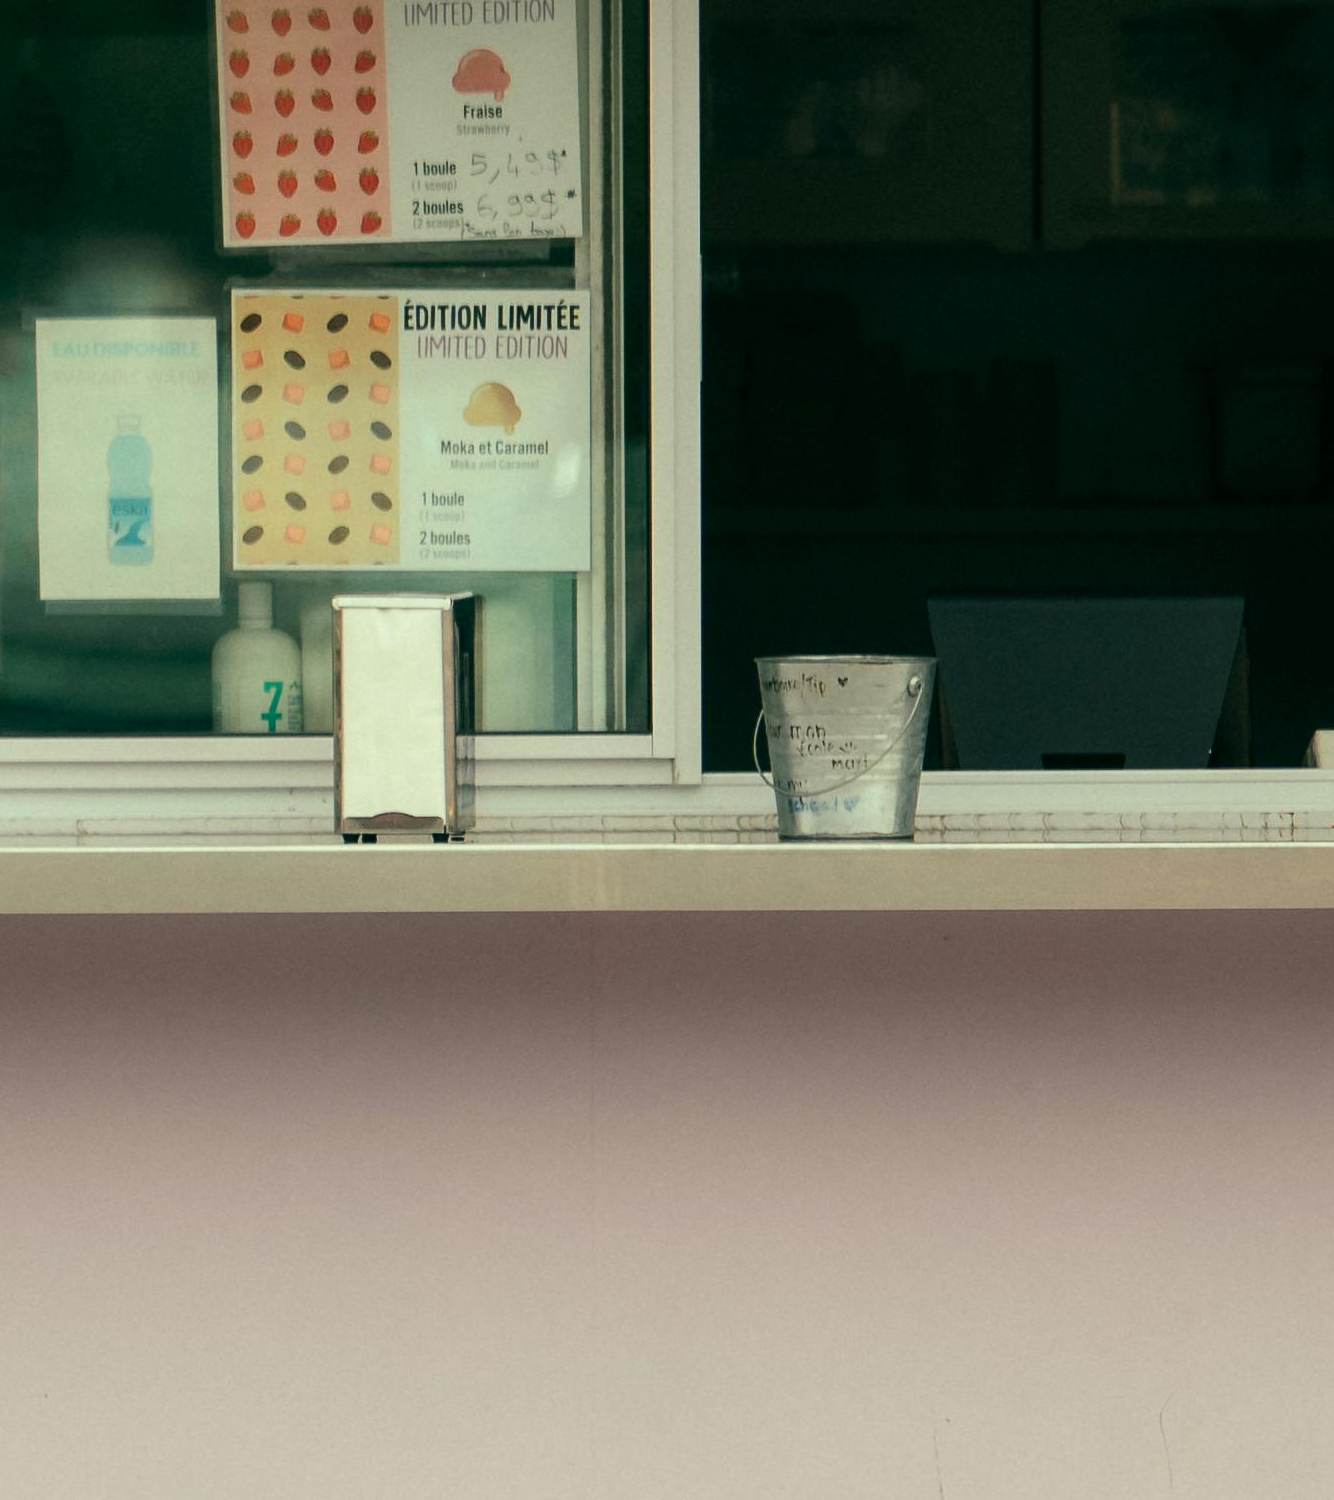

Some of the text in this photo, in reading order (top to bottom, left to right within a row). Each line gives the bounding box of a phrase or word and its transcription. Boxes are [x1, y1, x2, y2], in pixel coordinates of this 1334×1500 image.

[404, 1, 474, 27] LIMITED
[463, 104, 503, 120] Fraise
[412, 160, 457, 176] 1 boule
[412, 200, 464, 216] 2 boules
[403, 299, 581, 331] ÉDITION LIMITÉE
[417, 334, 568, 360] LIMITED EDITION
[441, 440, 549, 455] Moka et Caramel
[431, 492, 465, 506] boule
[419, 531, 471, 545] 2 boules
